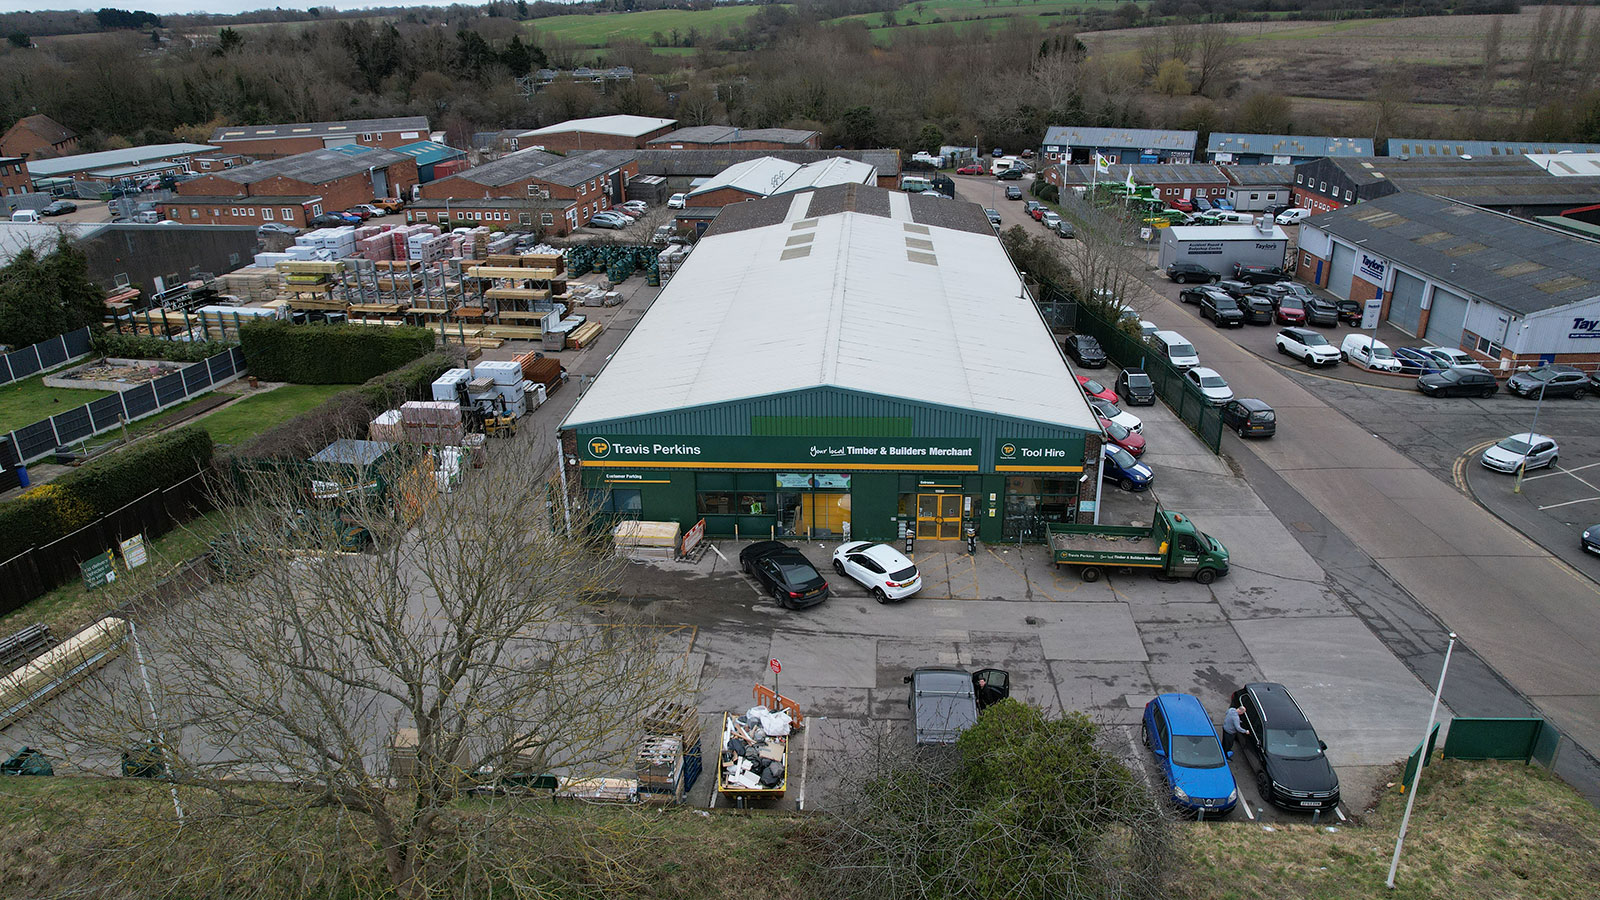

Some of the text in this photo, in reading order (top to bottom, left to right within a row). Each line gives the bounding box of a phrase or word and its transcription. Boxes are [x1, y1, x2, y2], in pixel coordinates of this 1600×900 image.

[1362, 254, 1385, 272] Taylor's
[612, 443, 701, 455] Travis Perkins
[829, 446, 846, 456] local
[847, 446, 878, 455] Timber
[880, 447, 887, 455] &
[889, 447, 926, 456] Builders
[929, 447, 972, 456] Merchant
[1021, 448, 1065, 457] Tool Hire
